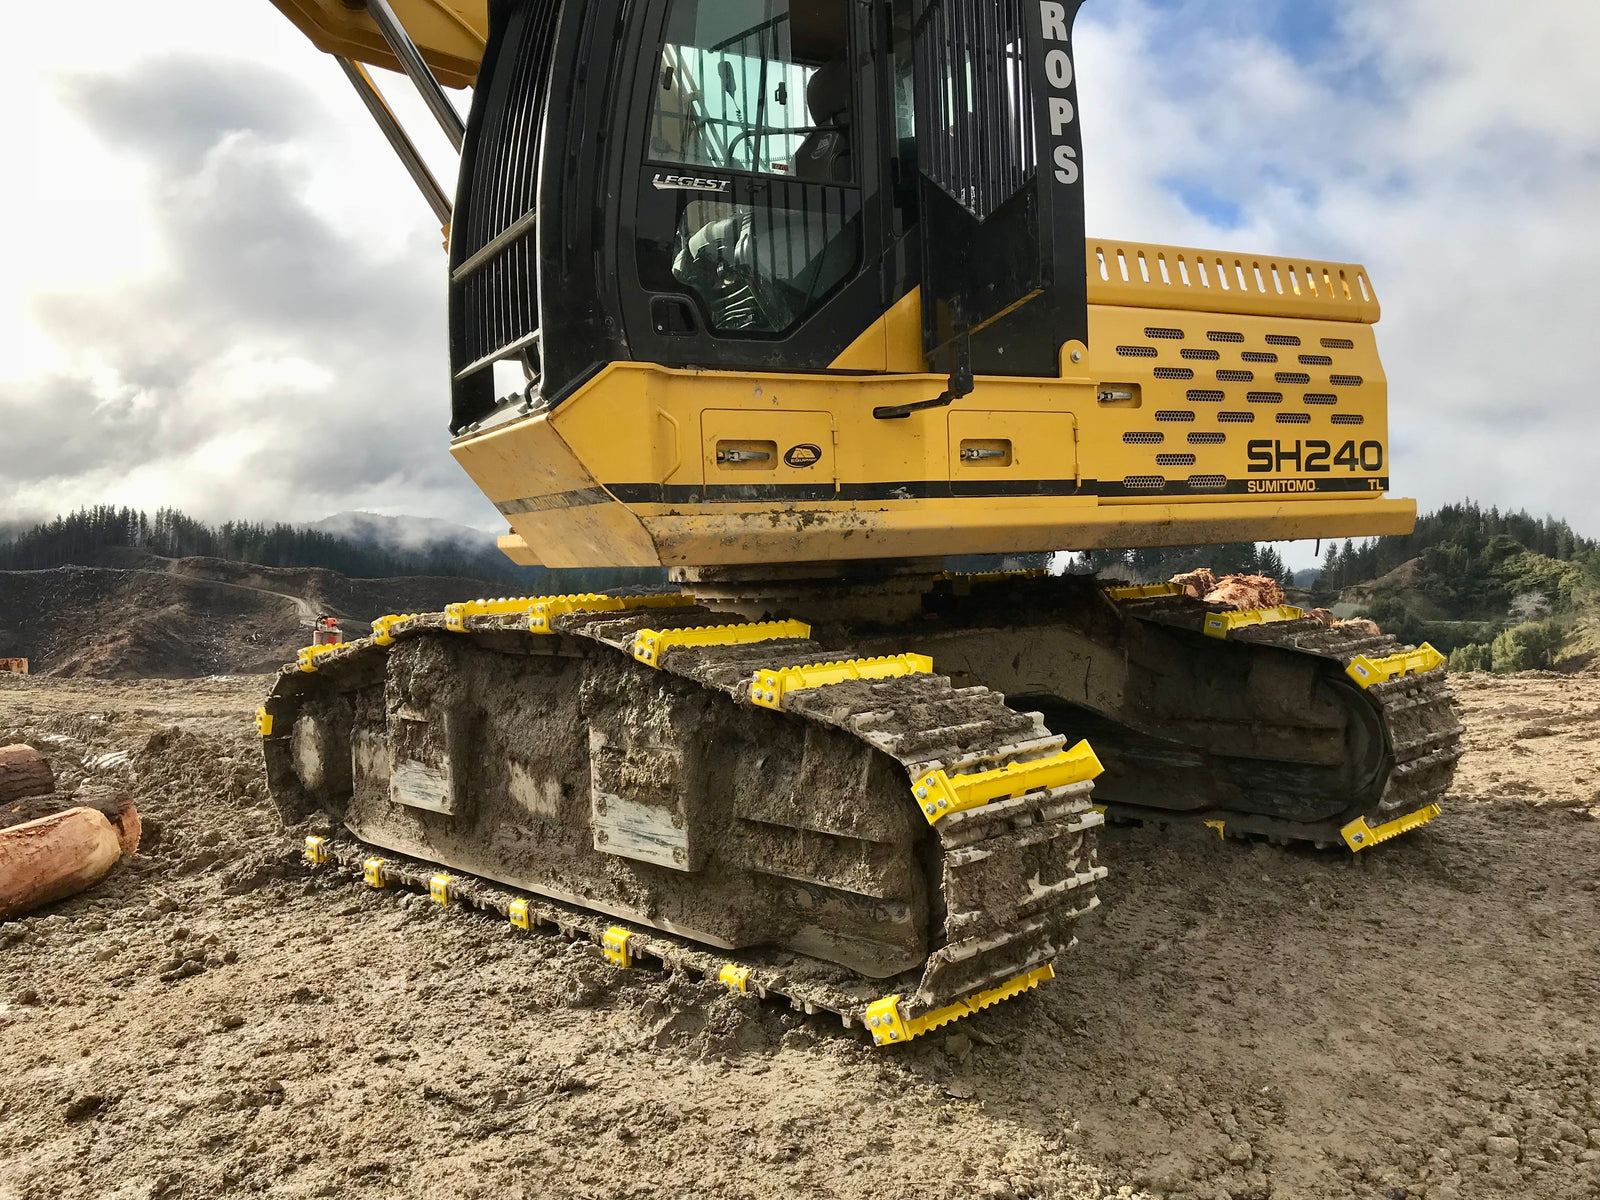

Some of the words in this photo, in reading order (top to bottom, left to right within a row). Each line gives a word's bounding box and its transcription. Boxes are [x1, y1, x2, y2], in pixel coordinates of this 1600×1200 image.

[1039, 0, 1079, 185] ROPS
[652, 173, 731, 192] LEGEST
[1247, 439, 1383, 473] SH240
[1247, 479, 1316, 493] SUMITOMO
[1367, 479, 1384, 491] TL
